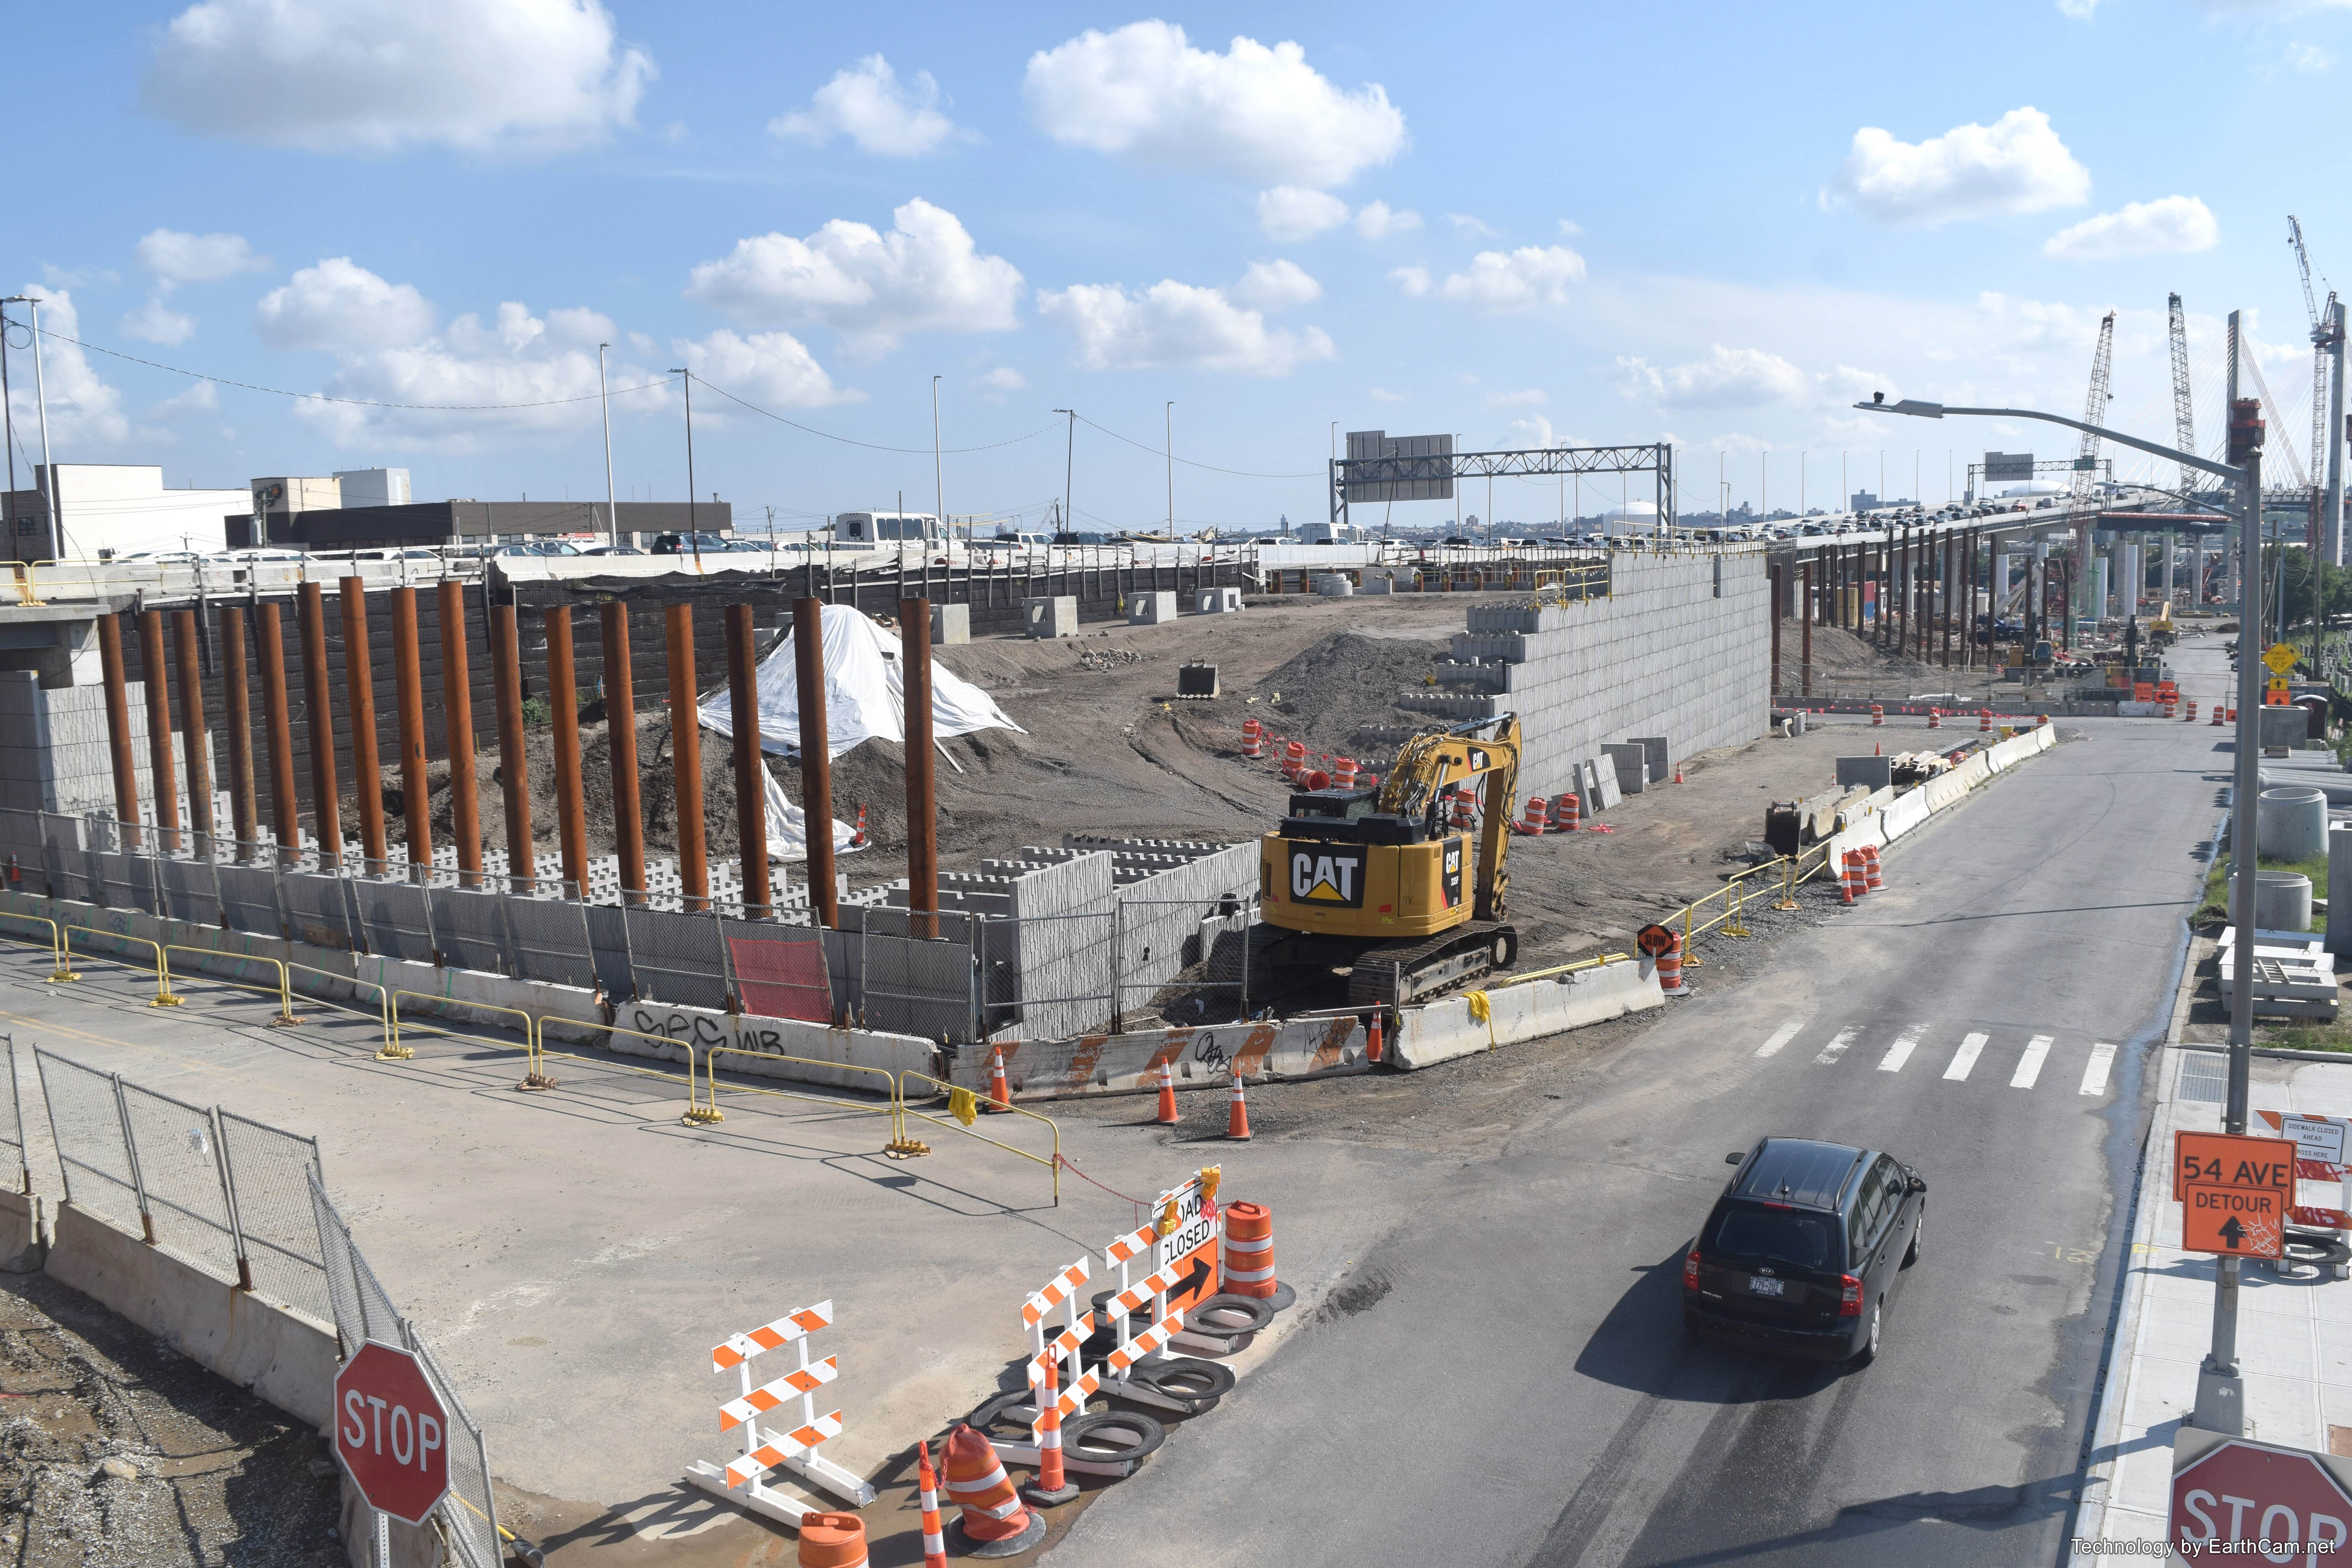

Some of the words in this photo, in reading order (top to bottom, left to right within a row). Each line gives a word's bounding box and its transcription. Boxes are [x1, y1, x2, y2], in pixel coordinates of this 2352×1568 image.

[1473, 751, 1483, 770] CAT
[1446, 851, 1459, 874] CAT
[1293, 853, 1358, 901] CAT
[1645, 934, 1666, 947] SLOW
[2288, 1123, 2315, 1132] SIDEWALK
[2183, 1156, 2222, 1181] 54
[2233, 1161, 2288, 1187] AVE
[1181, 1194, 1202, 1224] AD
[2196, 1192, 2271, 1213] DETOUR
[344, 1389, 441, 1472] STOP
[2181, 1489, 2347, 1568] STOP
